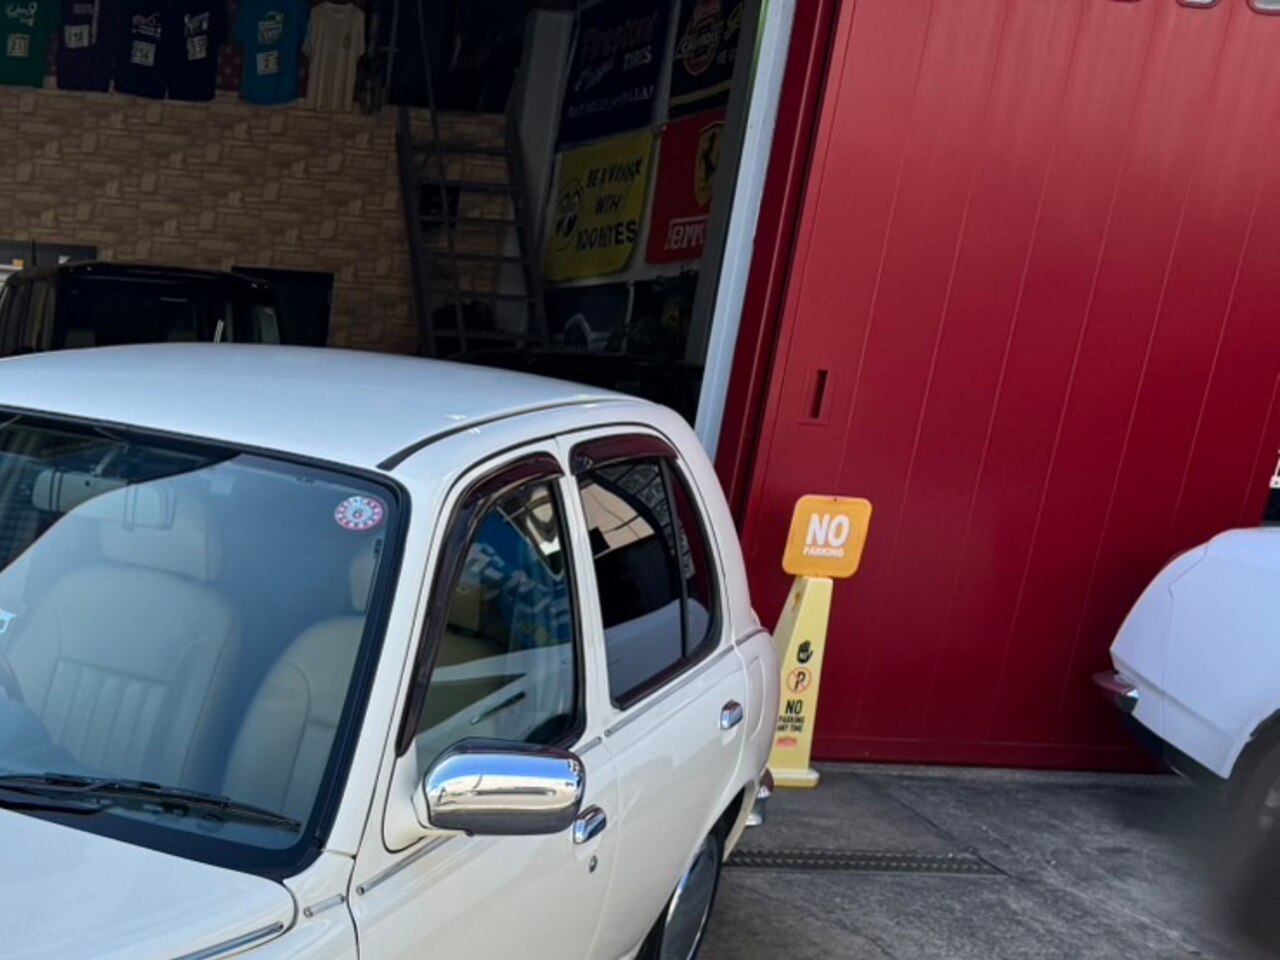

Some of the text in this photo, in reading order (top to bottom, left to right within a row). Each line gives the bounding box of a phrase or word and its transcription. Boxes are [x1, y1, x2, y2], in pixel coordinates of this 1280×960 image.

[805, 512, 850, 547] NO
[803, 545, 844, 558] PARKING
[785, 699, 803, 715] NO
